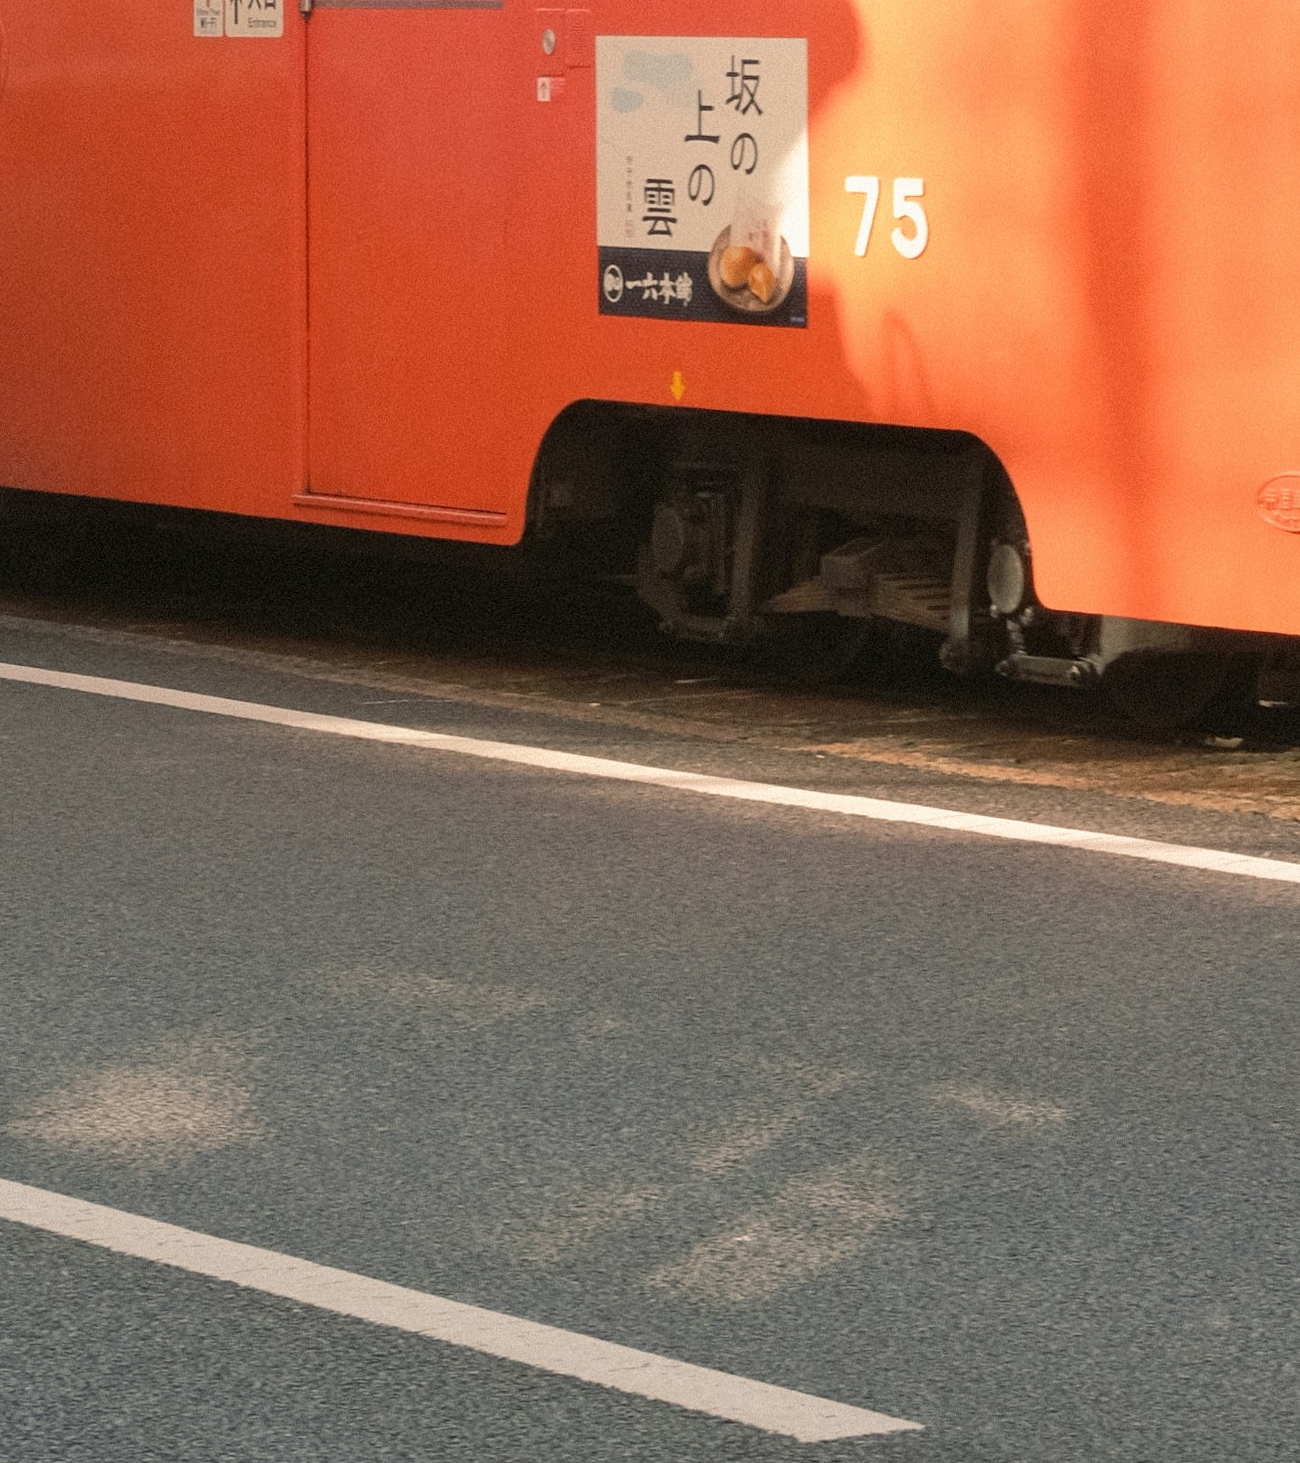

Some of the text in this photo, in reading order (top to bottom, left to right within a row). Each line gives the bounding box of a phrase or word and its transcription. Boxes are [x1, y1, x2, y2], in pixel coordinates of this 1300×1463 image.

[684, 89, 721, 207] 上の
[725, 54, 764, 175] 坂の
[642, 178, 678, 237] 雲
[844, 175, 929, 260] 75
